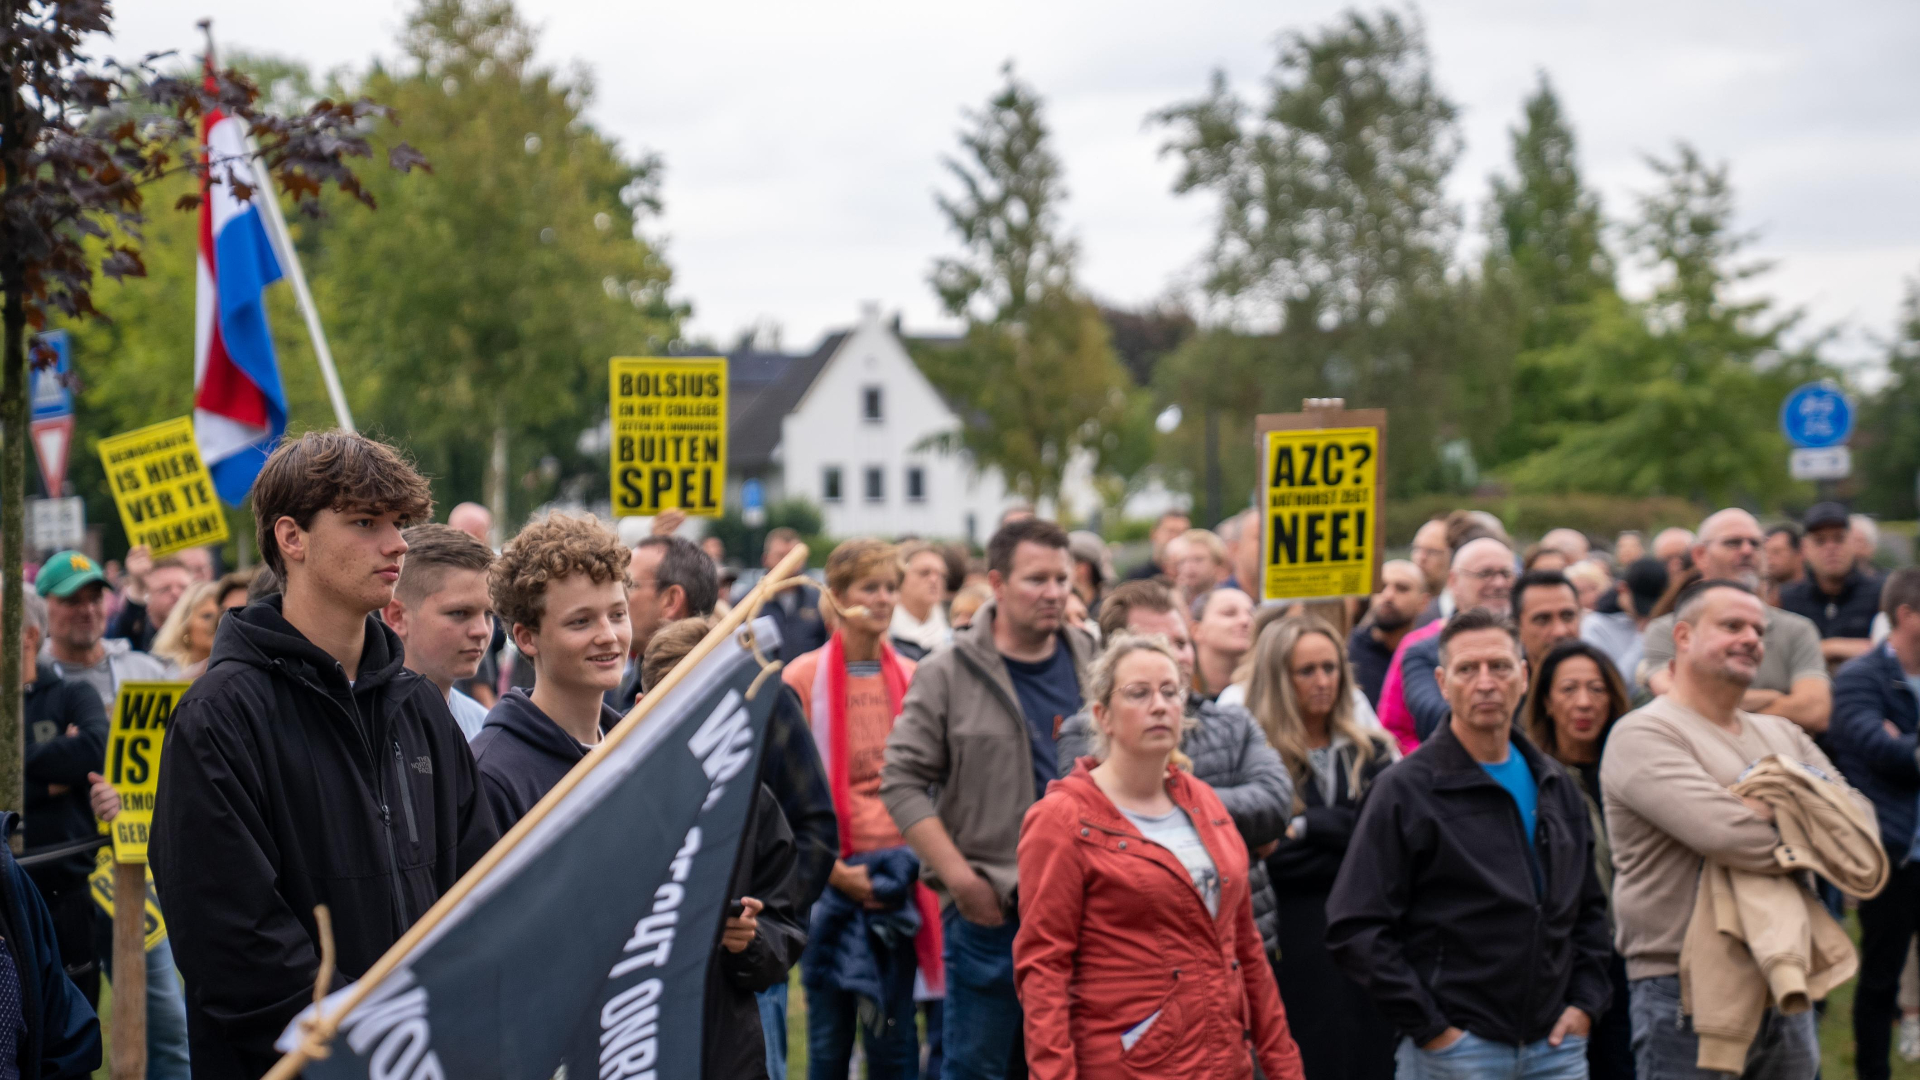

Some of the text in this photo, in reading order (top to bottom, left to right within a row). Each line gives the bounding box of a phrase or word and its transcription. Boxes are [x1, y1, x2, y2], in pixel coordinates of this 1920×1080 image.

[619, 373, 719, 397] BOLSIUS
[638, 403, 660, 417] HET
[666, 403, 719, 417] COLLEGE
[619, 436, 719, 463] BUITEN
[1273, 444, 1372, 487] AZC?
[115, 450, 199, 493] IS HIER
[619, 467, 717, 509] SPEL
[126, 478, 210, 523] VER TE
[1272, 510, 1366, 564] NEE!
[119, 692, 178, 731] WA
[111, 734, 151, 785] IS
[117, 822, 151, 844] GEB
[599, 977, 661, 1080] ONR
